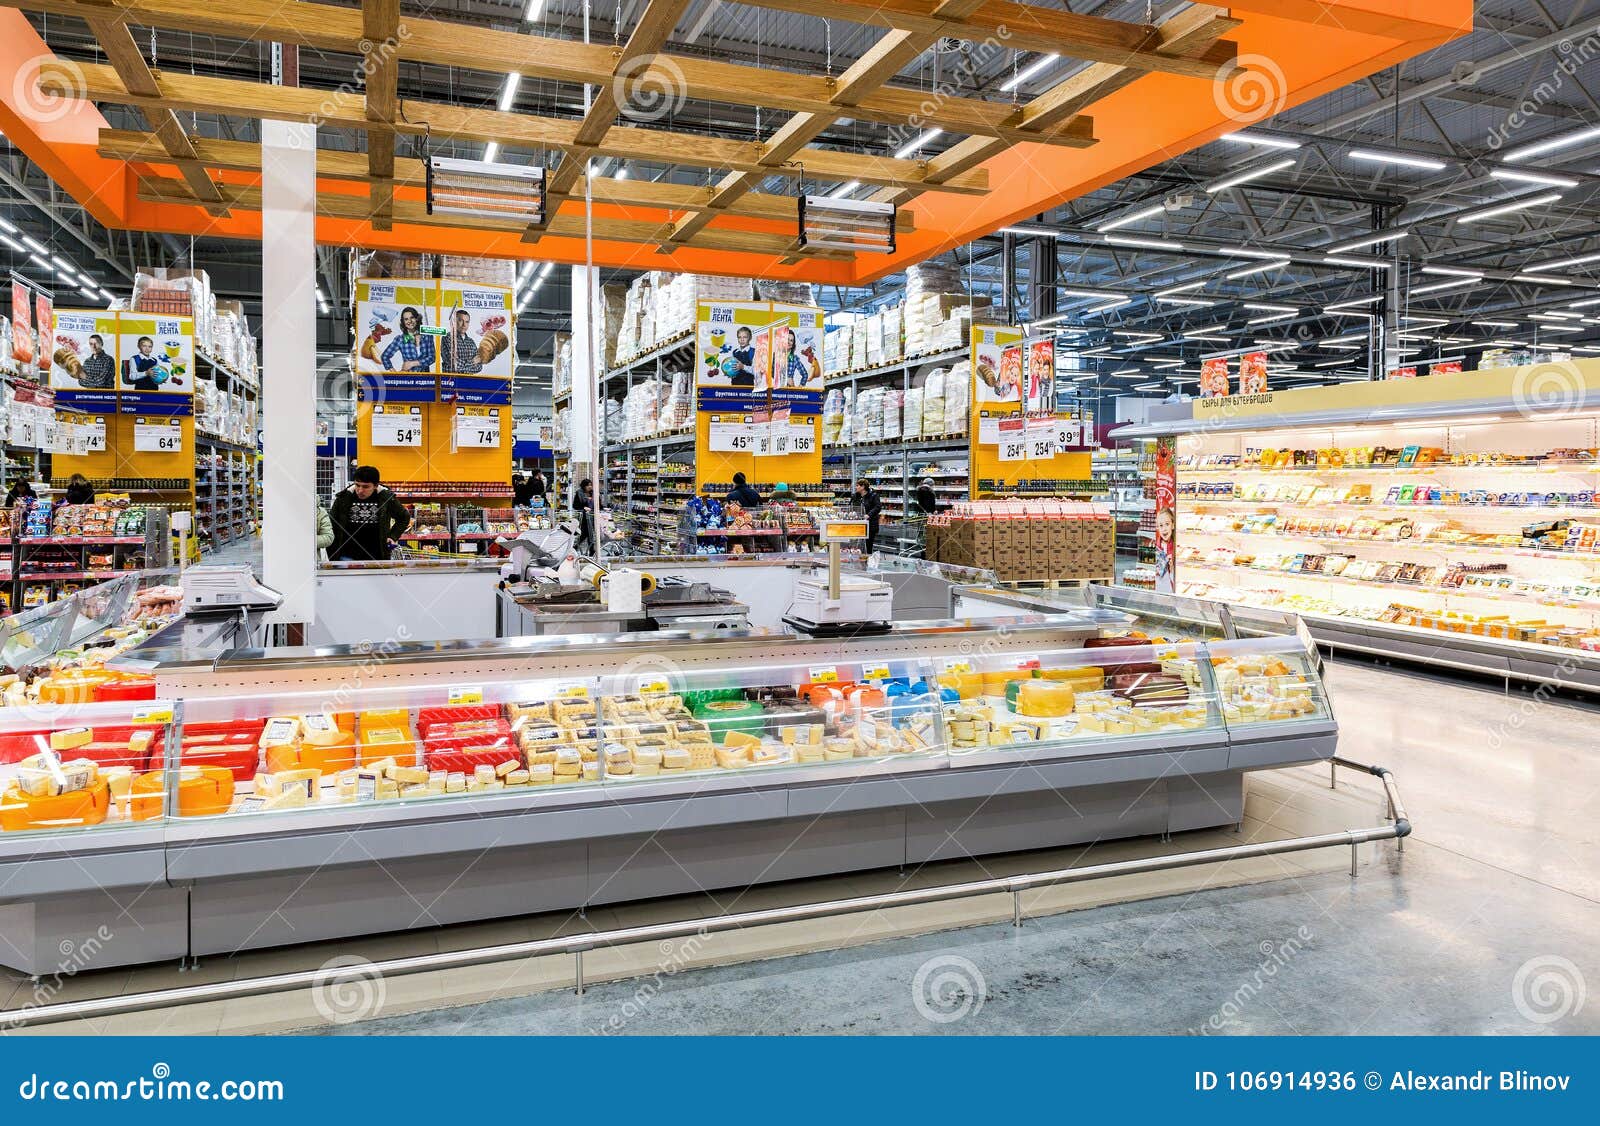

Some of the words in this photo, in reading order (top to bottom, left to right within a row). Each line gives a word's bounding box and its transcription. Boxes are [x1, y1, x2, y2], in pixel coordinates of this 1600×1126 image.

[712, 314, 732, 323] ЛЕНТА
[158, 327, 179, 335] ЛЕНТА
[1202, 399, 1219, 408] СЫРЫ
[1233, 394, 1273, 405] БУТЕРБРОДОВ
[397, 429, 412, 443] 54
[478, 430, 492, 444] 74
[732, 436, 746, 449] 45
[1059, 432, 1073, 443] 39
[159, 437, 174, 449] 64
[794, 437, 809, 450] 156
[1035, 441, 1048, 456] 254
[1007, 445, 1019, 458] 254
